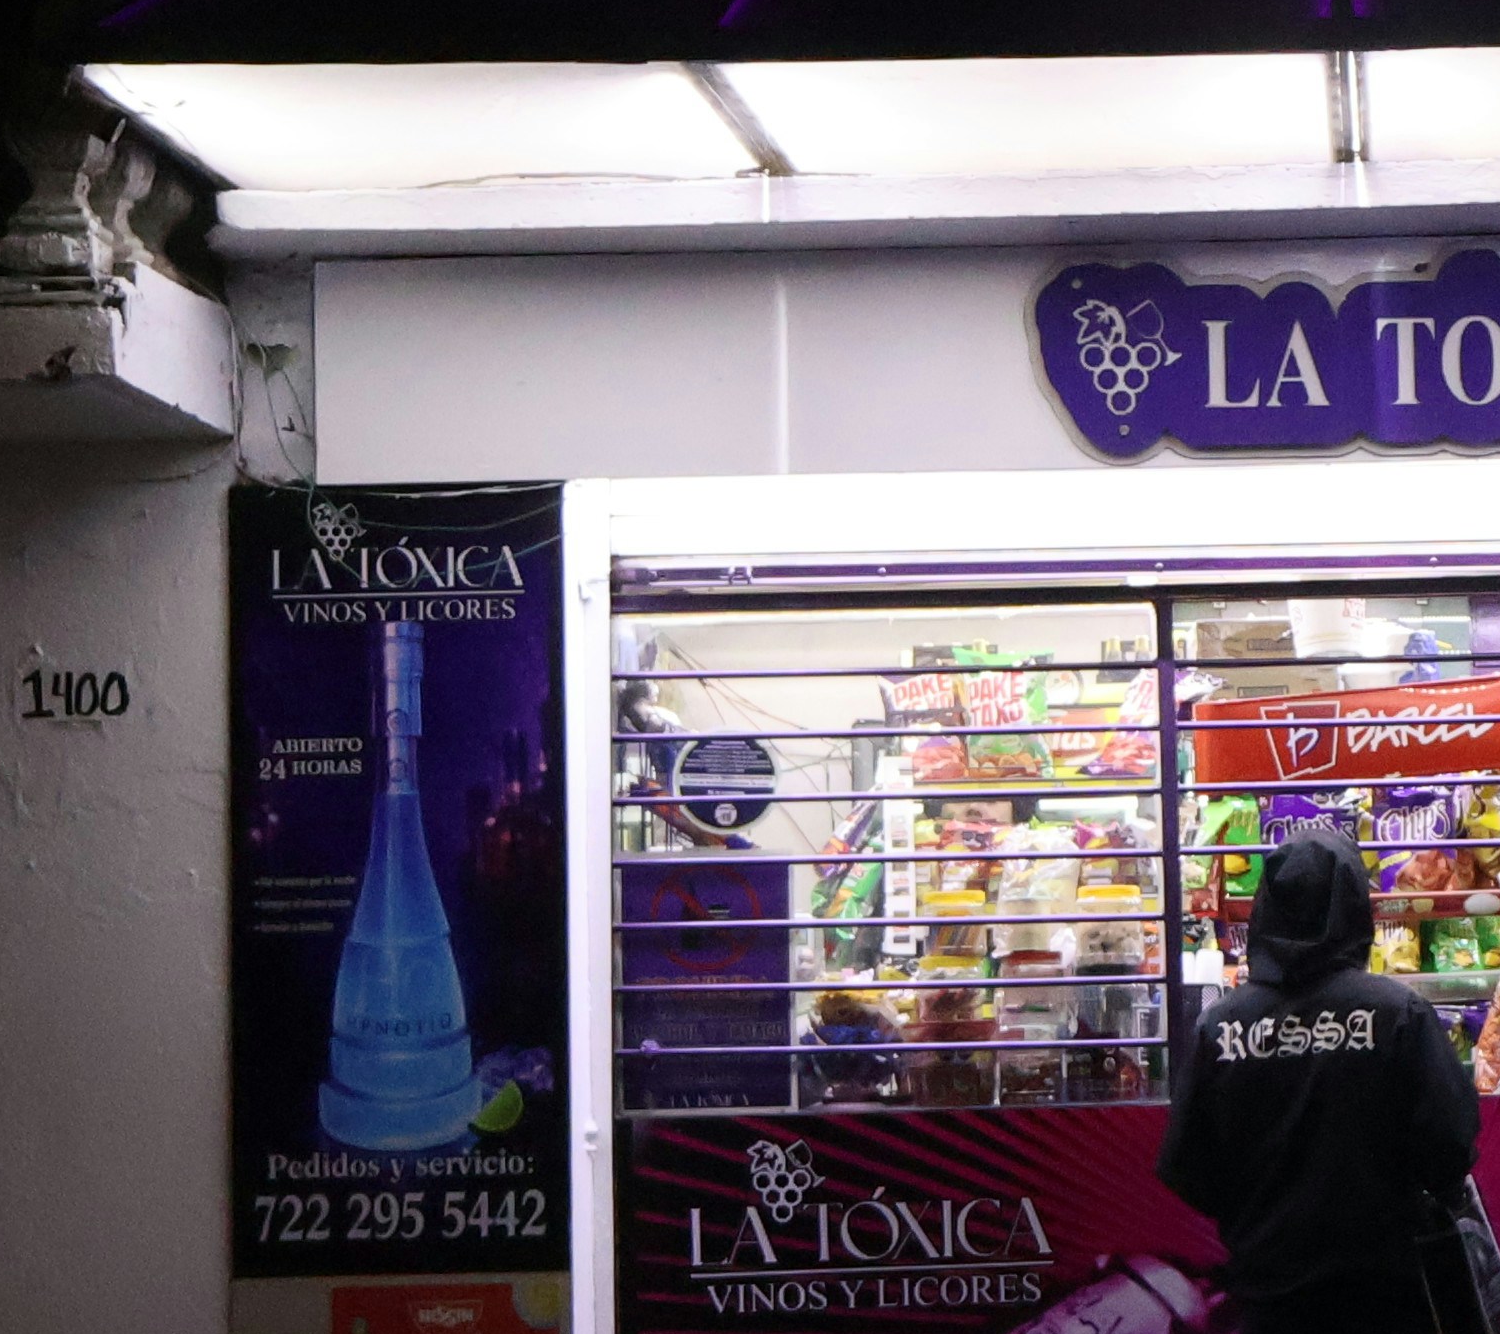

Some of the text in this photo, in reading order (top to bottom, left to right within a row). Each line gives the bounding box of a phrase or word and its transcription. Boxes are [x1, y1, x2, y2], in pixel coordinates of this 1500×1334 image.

[1203, 319, 1331, 409] LA
[272, 536, 525, 590] LA TÓXICA
[283, 597, 518, 624] VINOS Y LICORES
[21, 668, 131, 719] 1400
[272, 737, 364, 754] ABIERTO
[1345, 702, 1495, 753] BARCEL
[259, 757, 364, 781] 24 HORAS
[1215, 1008, 1377, 1063] RESSA
[268, 1149, 536, 1184] Pedidos y servicio:
[254, 1187, 548, 1243] 722 295 5442
[690, 1185, 1055, 1267] LA TÓXICA
[706, 1271, 1043, 1315] VINOS Y LICORES
